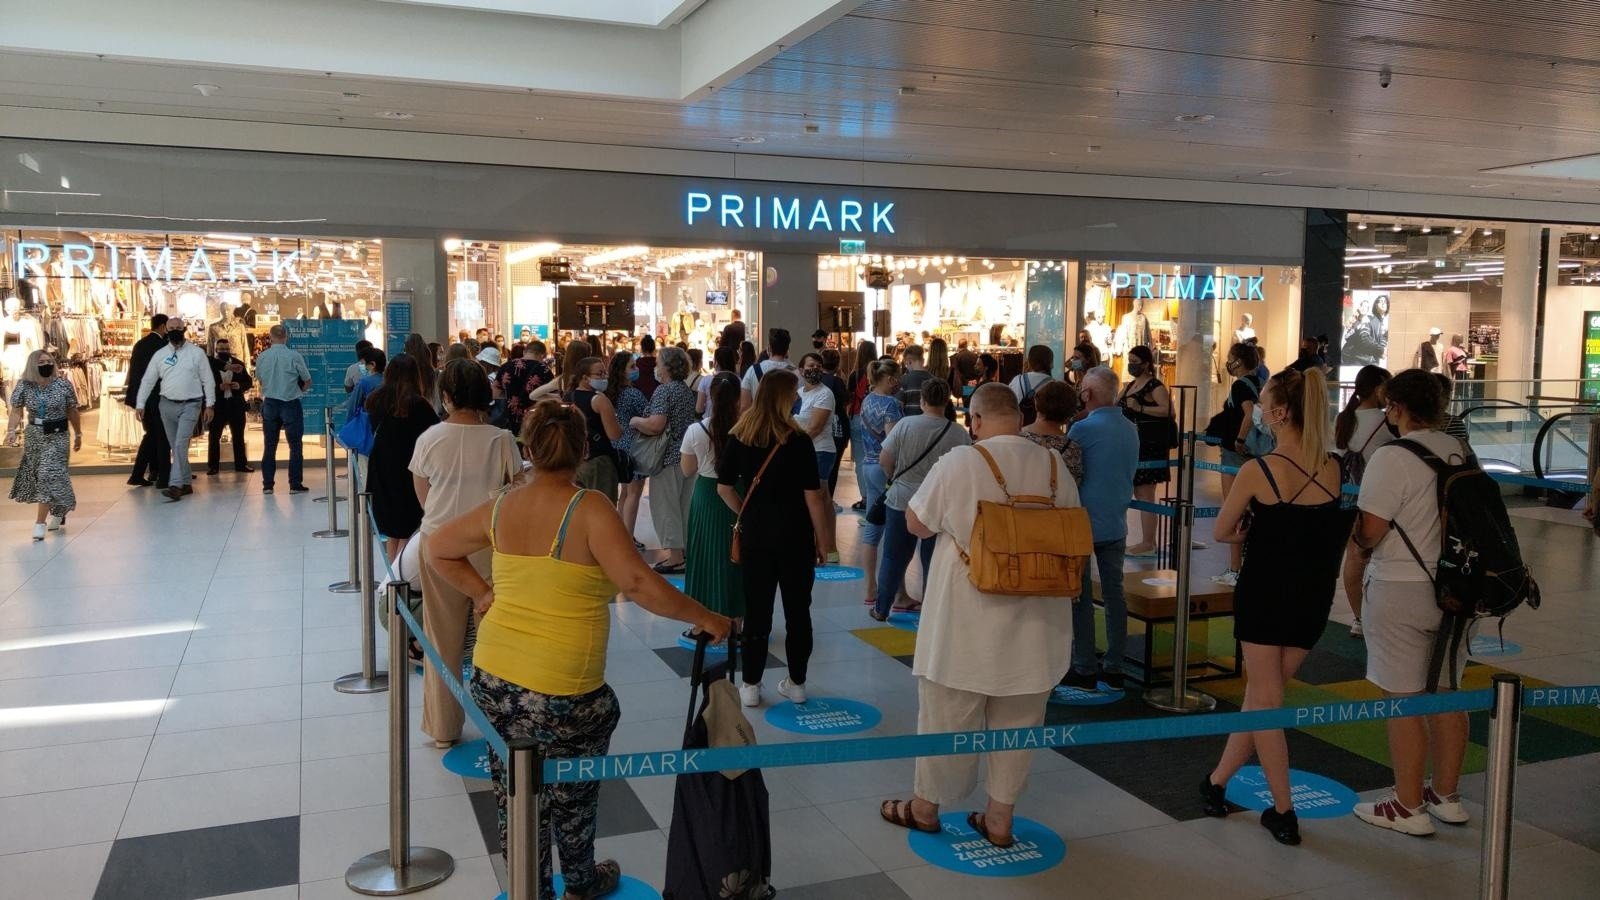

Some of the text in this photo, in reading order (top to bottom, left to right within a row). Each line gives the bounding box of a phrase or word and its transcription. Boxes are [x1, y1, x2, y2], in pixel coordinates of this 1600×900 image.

[687, 192, 896, 235] PRIMARK
[17, 242, 303, 286] PRIMARK
[1111, 273, 1265, 301] PRIMARK
[1296, 699, 1403, 725] PRIMARK
[953, 726, 1077, 753] PRIMARK
[556, 750, 700, 781] PRIMARK
[955, 840, 1039, 861] ZACHOWAJ
[973, 849, 1043, 869] DYSTANS
